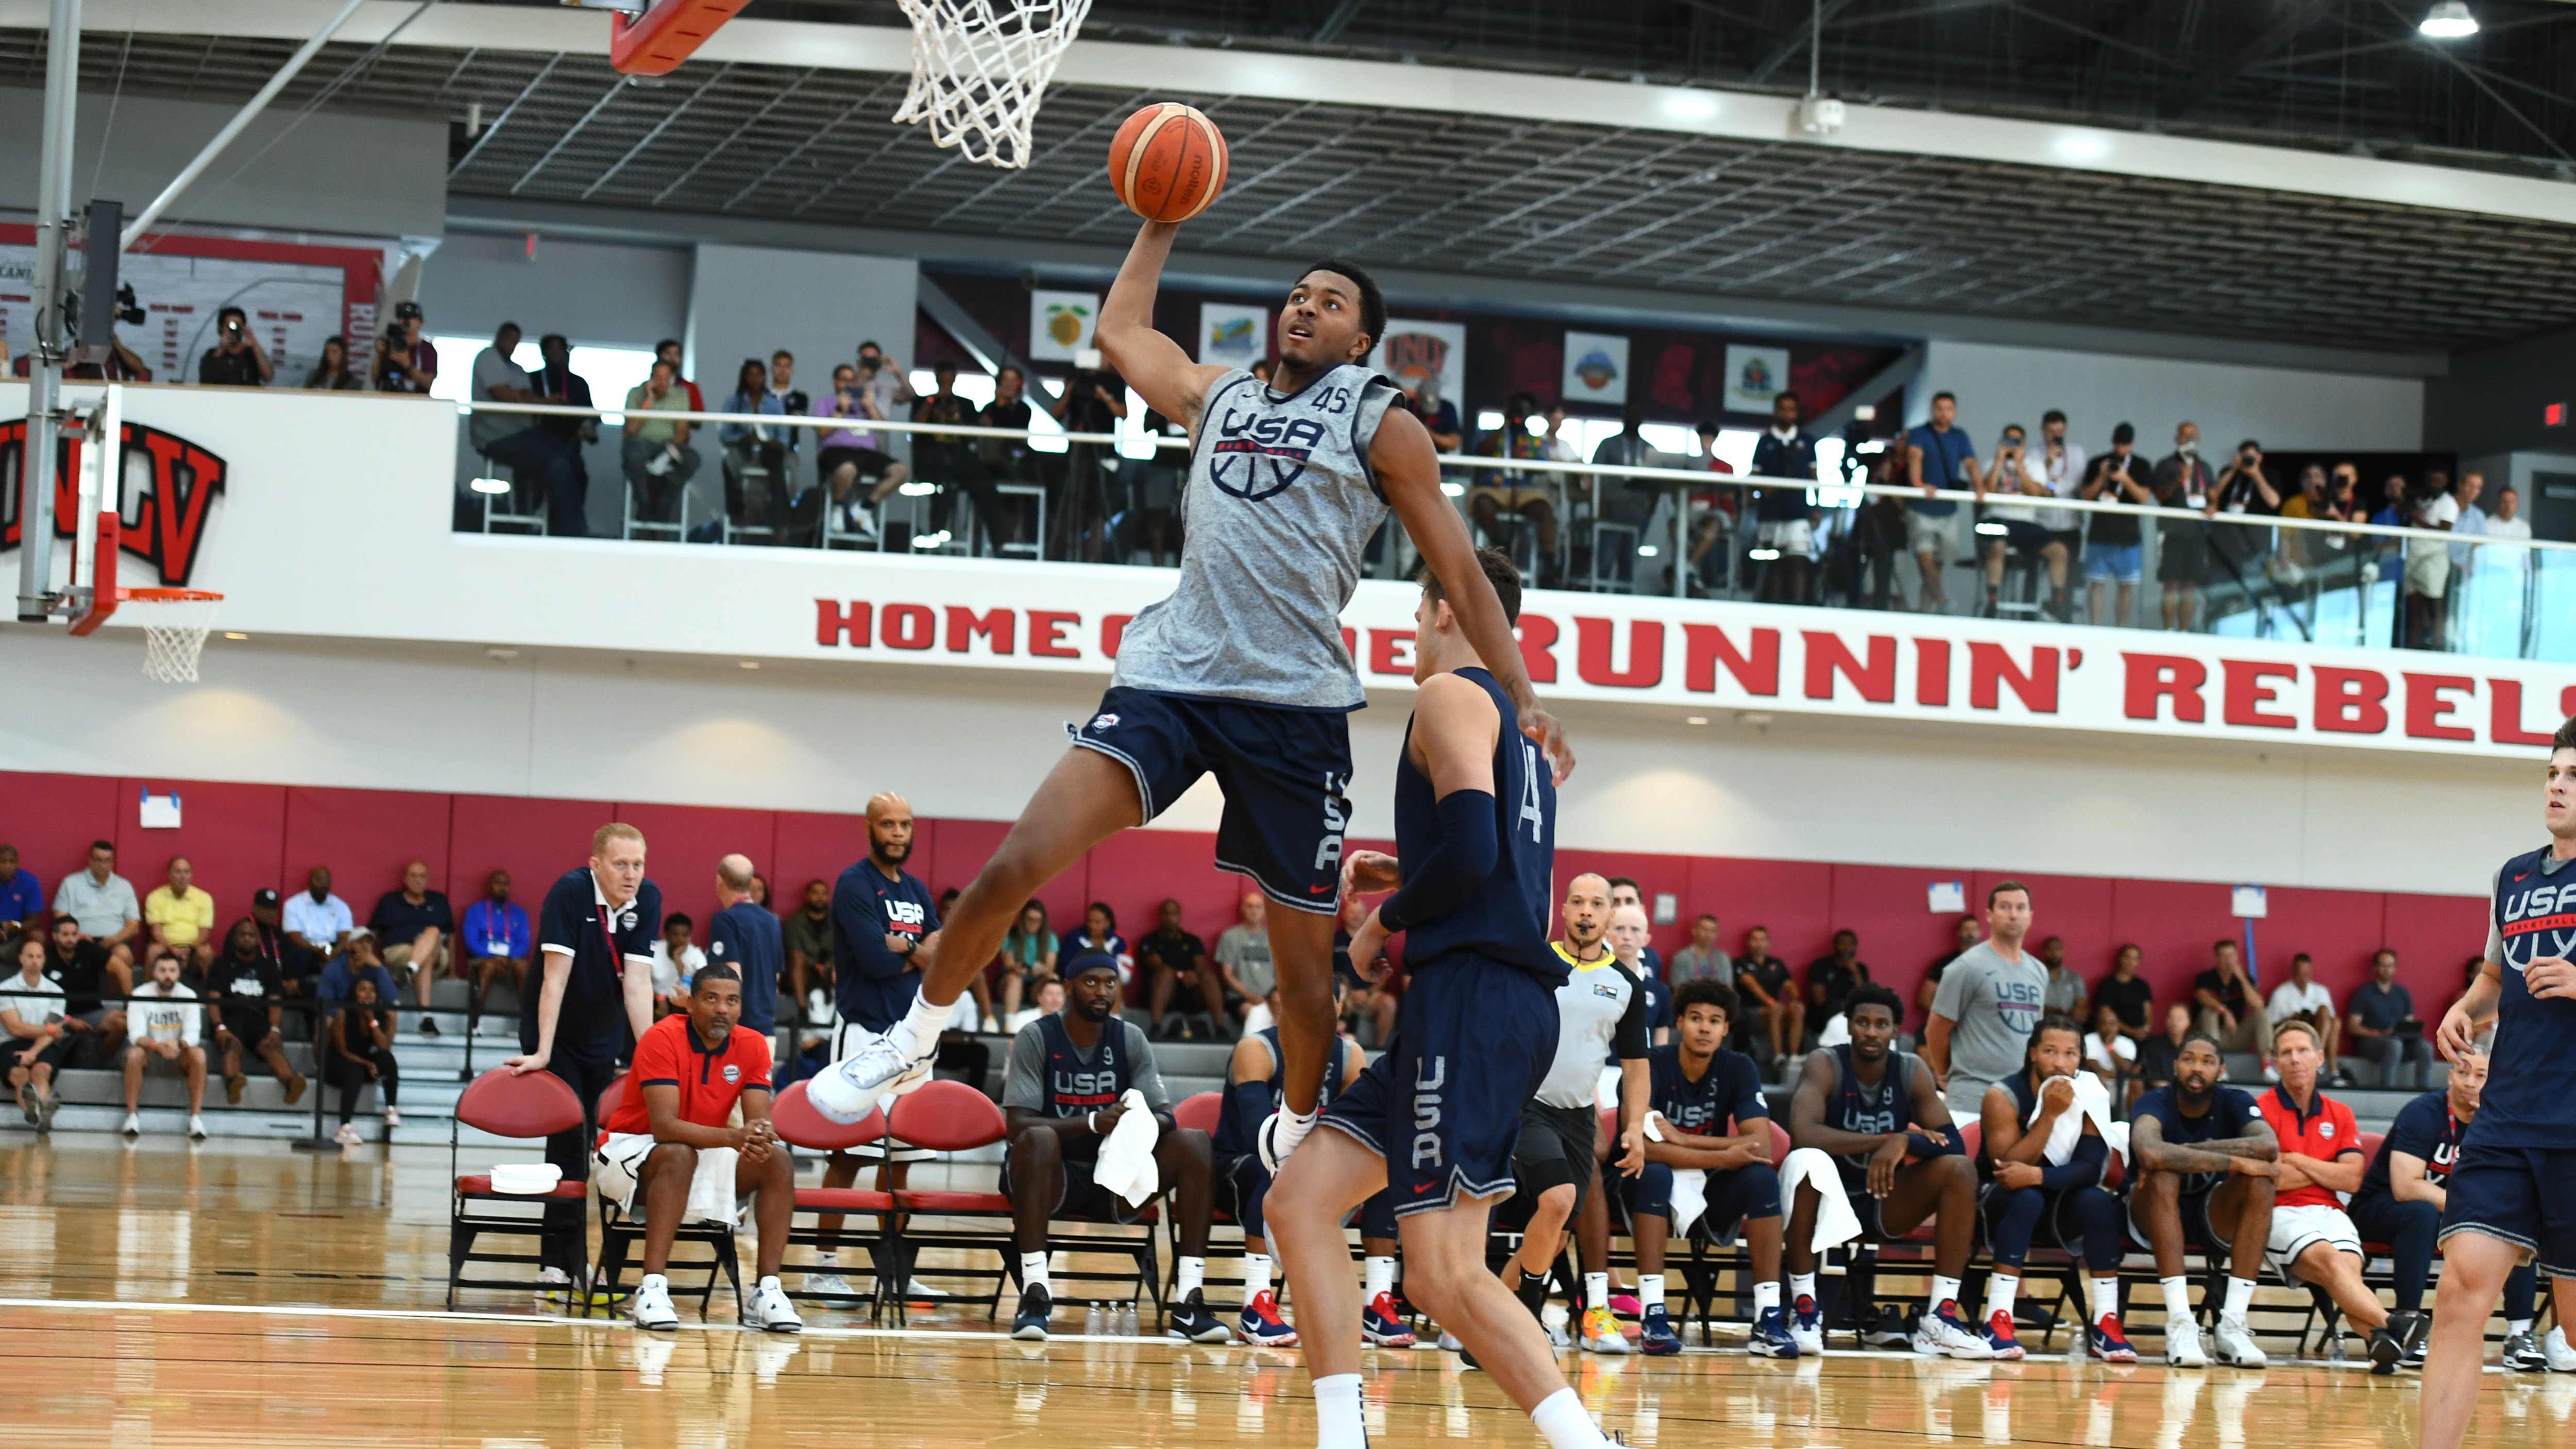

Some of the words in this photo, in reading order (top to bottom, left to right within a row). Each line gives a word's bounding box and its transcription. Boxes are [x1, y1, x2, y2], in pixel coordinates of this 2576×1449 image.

[349, 303, 375, 381] RUNN
[1311, 386, 1350, 414] 45
[1221, 407, 1326, 448] USA
[814, 599, 1081, 659] HOME
[2120, 652, 2576, 747] REBEL
[885, 899, 924, 925] USA
[1995, 982, 2040, 1001] USA
[1103, 1046, 1114, 1065] 9
[1054, 1070, 1116, 1095] USA
[1412, 1056, 1445, 1169] USA
[1666, 1101, 1715, 1128] USA
[1843, 1107, 1894, 1134] USA
